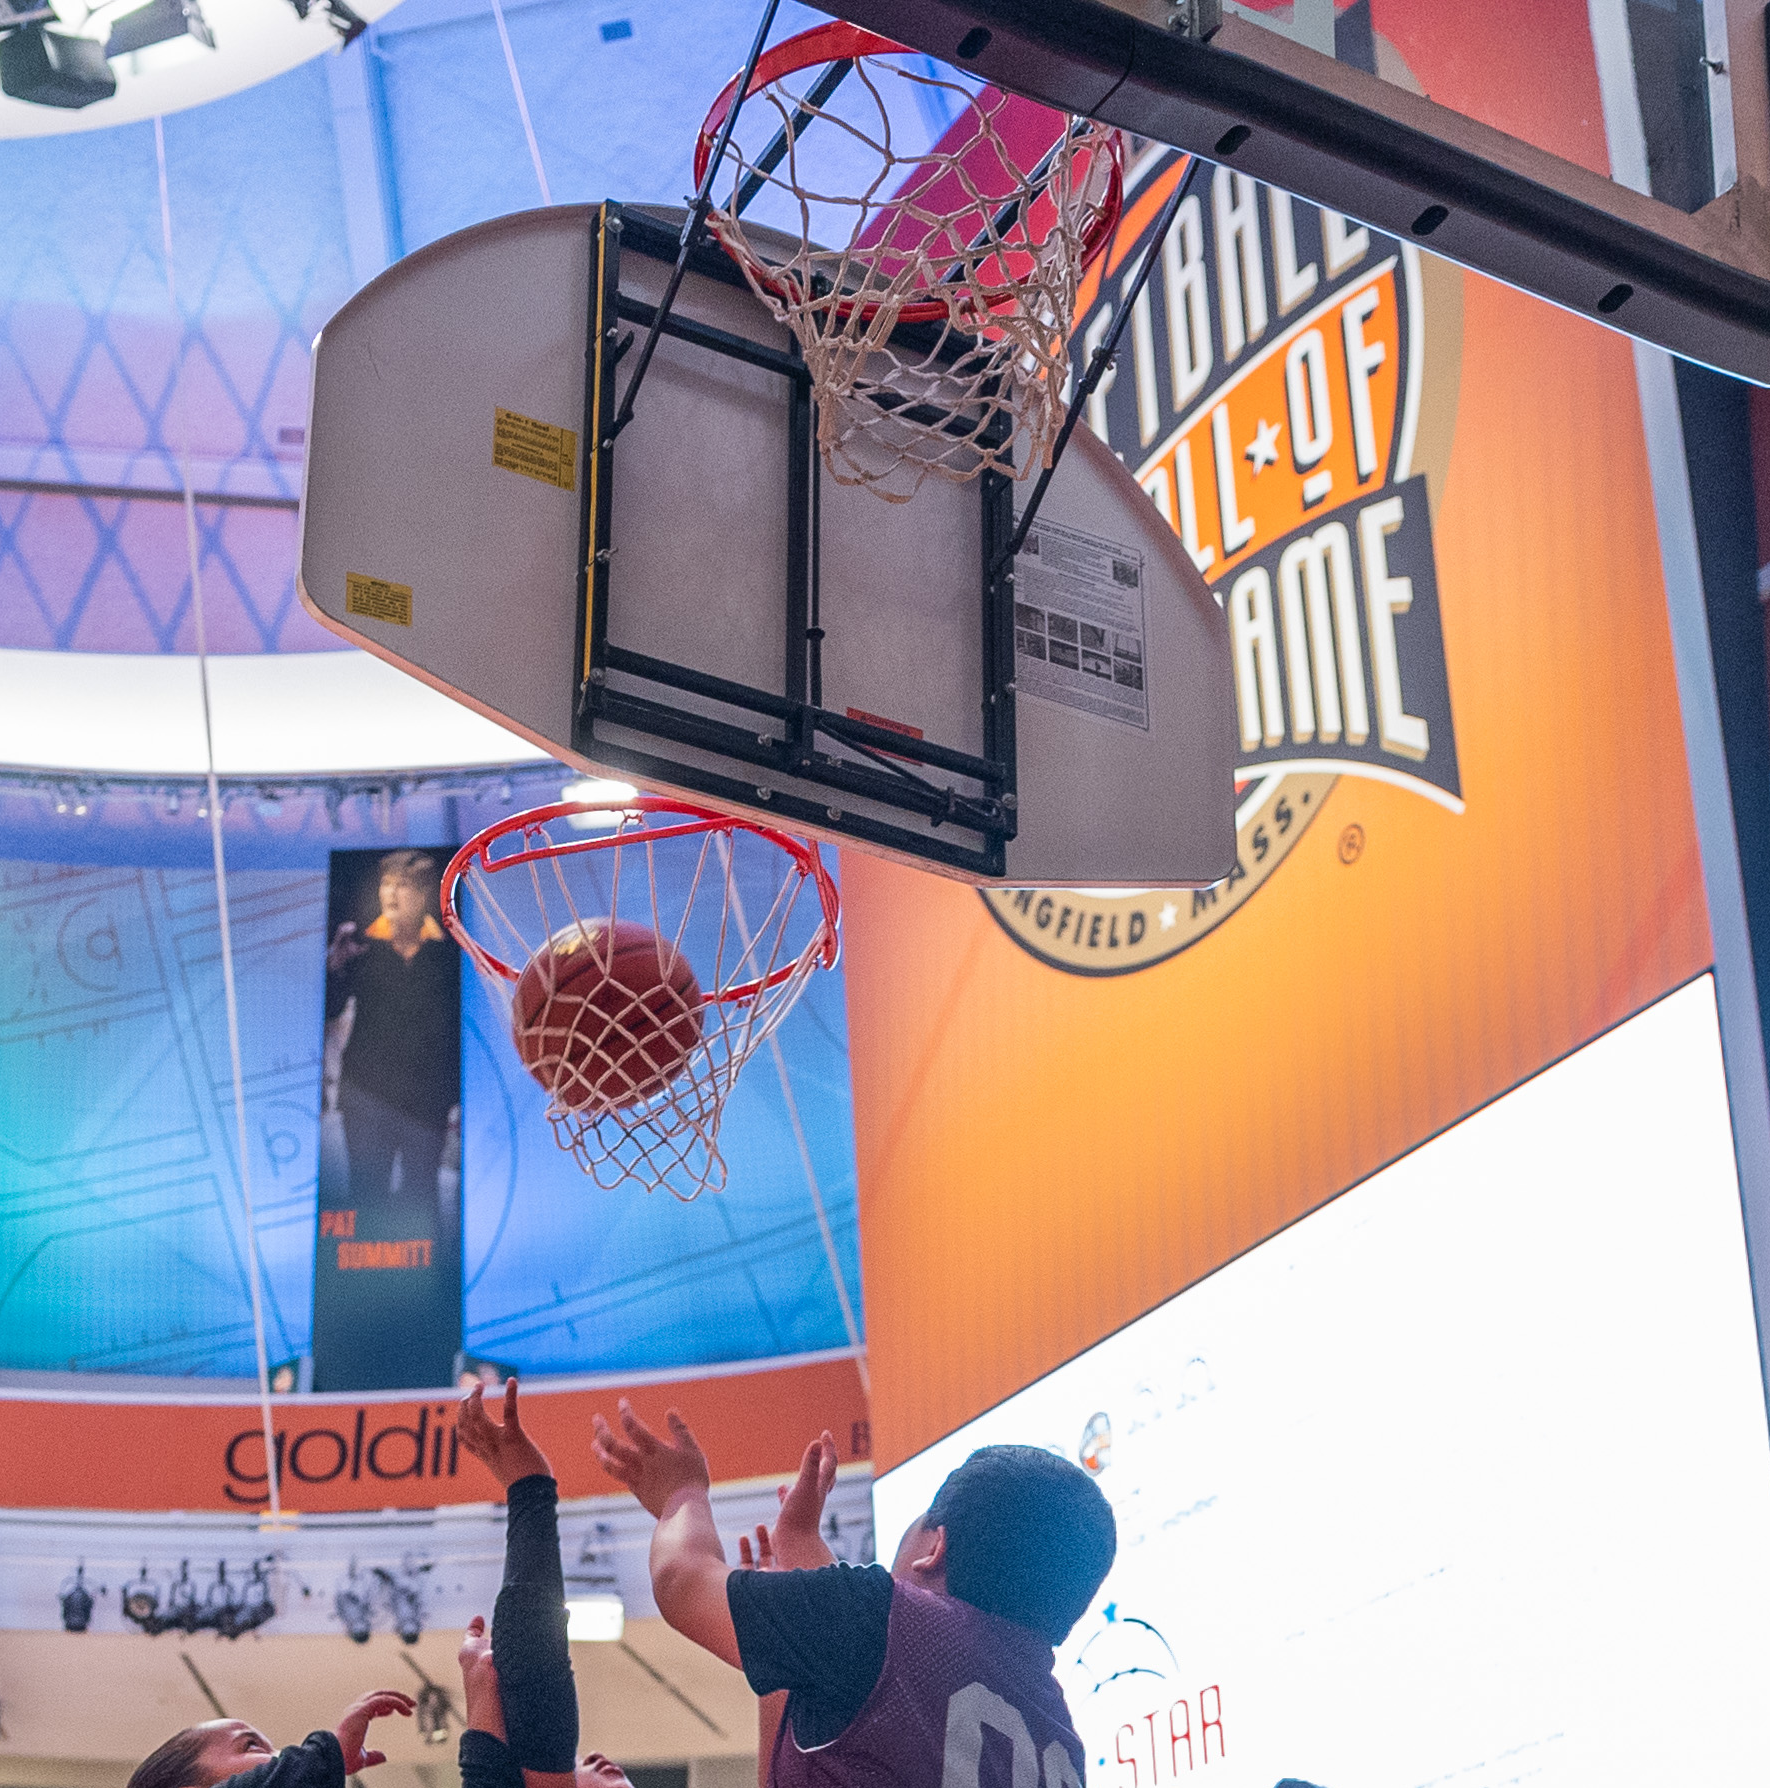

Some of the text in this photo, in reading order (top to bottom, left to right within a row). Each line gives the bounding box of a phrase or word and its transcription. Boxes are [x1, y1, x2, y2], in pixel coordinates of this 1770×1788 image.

[1284, 286, 1388, 486] OF
[1227, 495, 1431, 762] AME
[320, 1211, 358, 1238] PAT
